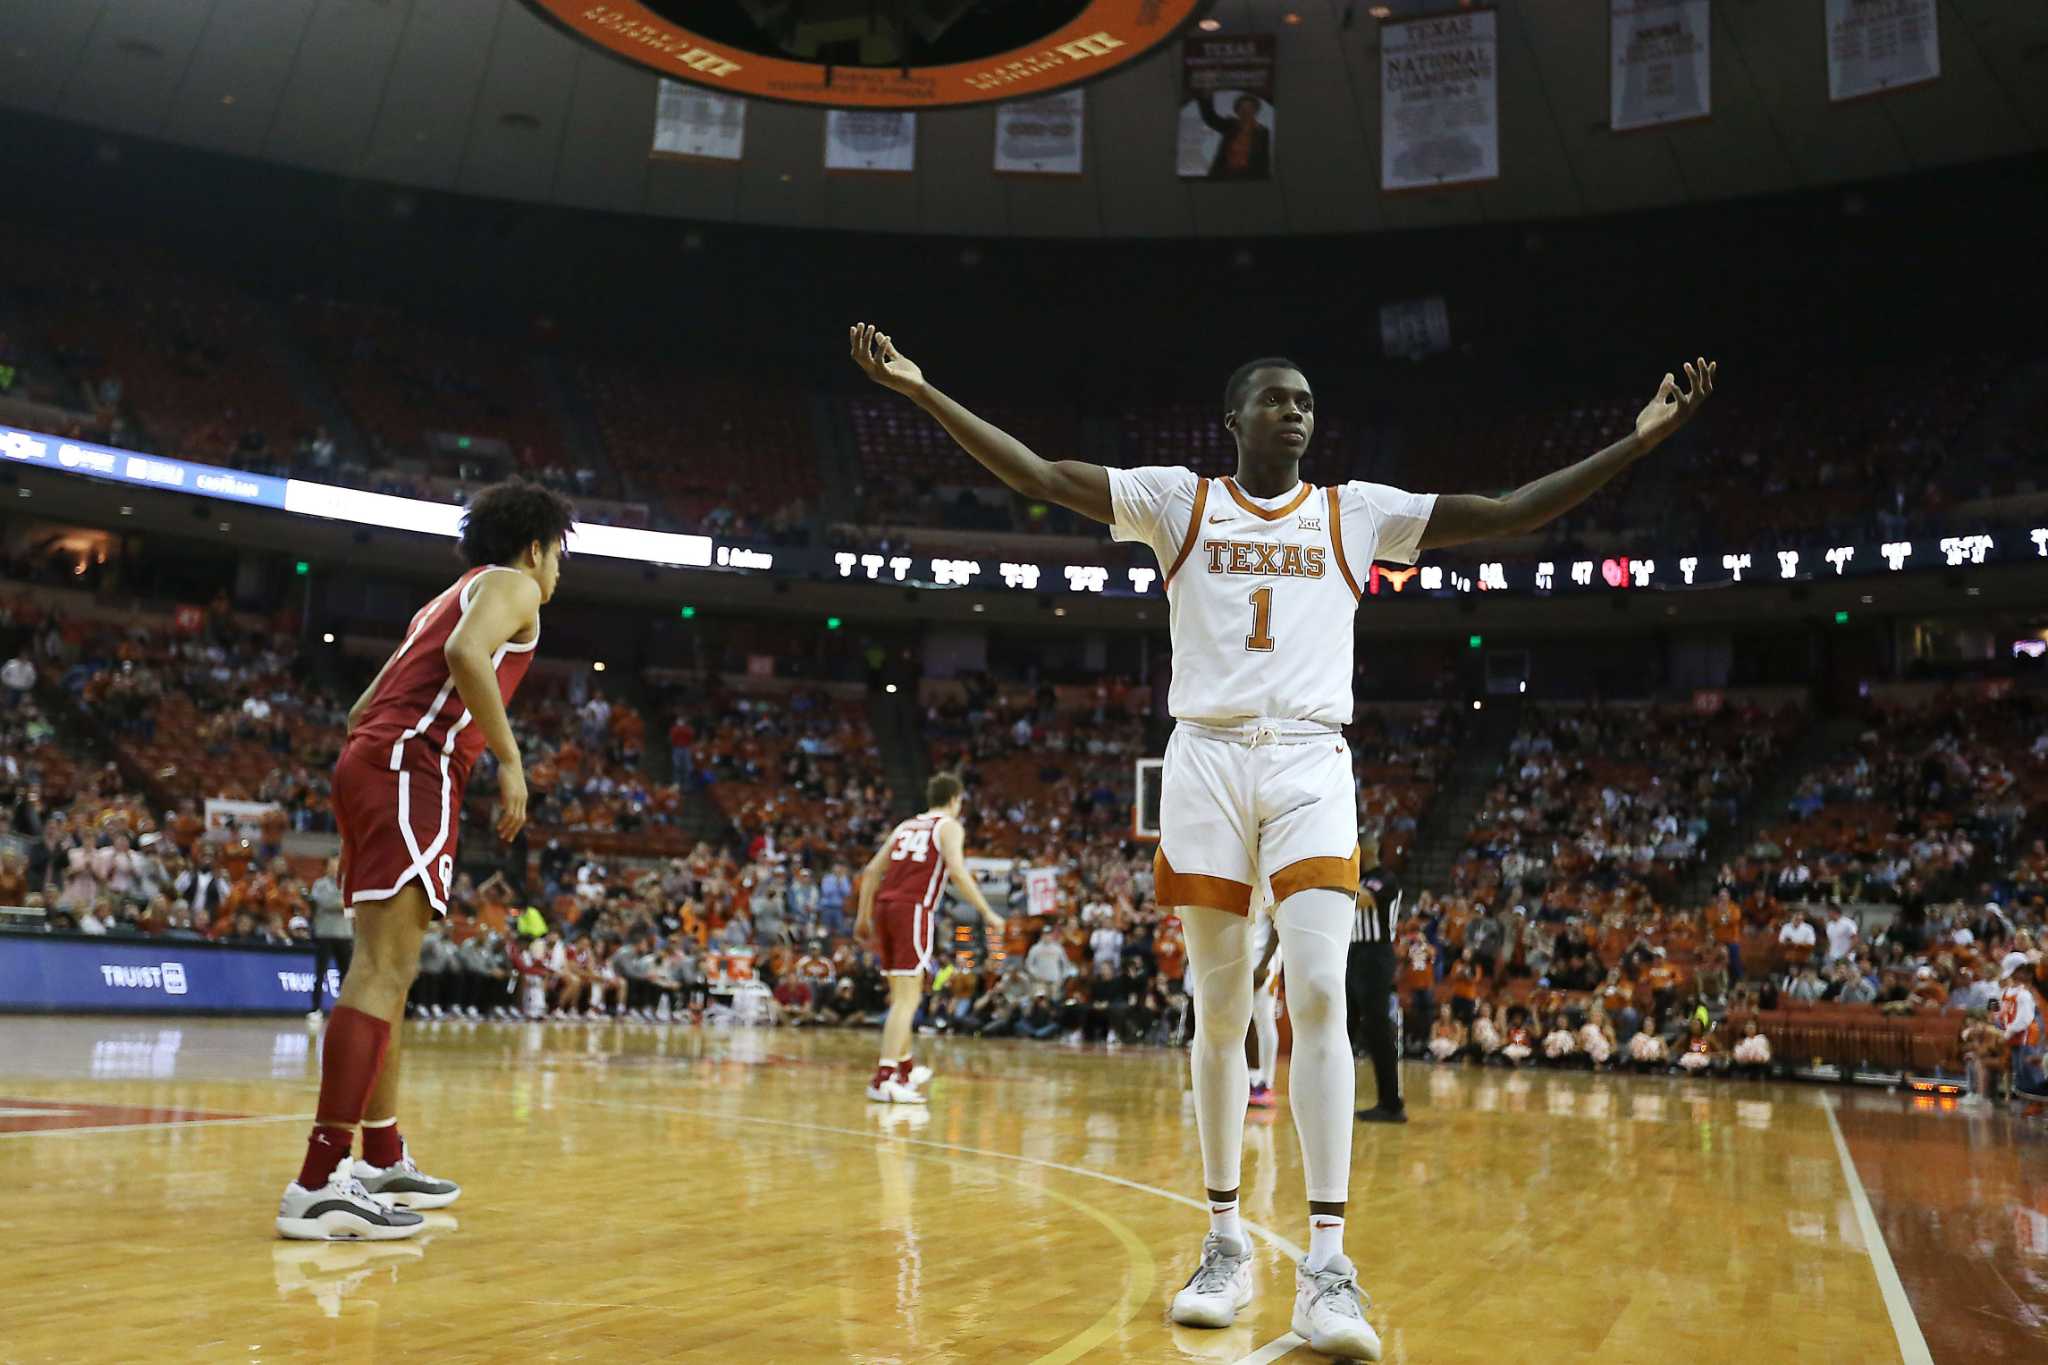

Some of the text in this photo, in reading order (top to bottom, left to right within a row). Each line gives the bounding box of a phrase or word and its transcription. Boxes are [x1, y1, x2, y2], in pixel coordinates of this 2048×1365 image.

[1204, 539, 1326, 579] TEXAS
[1245, 586, 1275, 652] 1
[891, 830, 931, 862] 34
[100, 965, 162, 988] TRUIST
